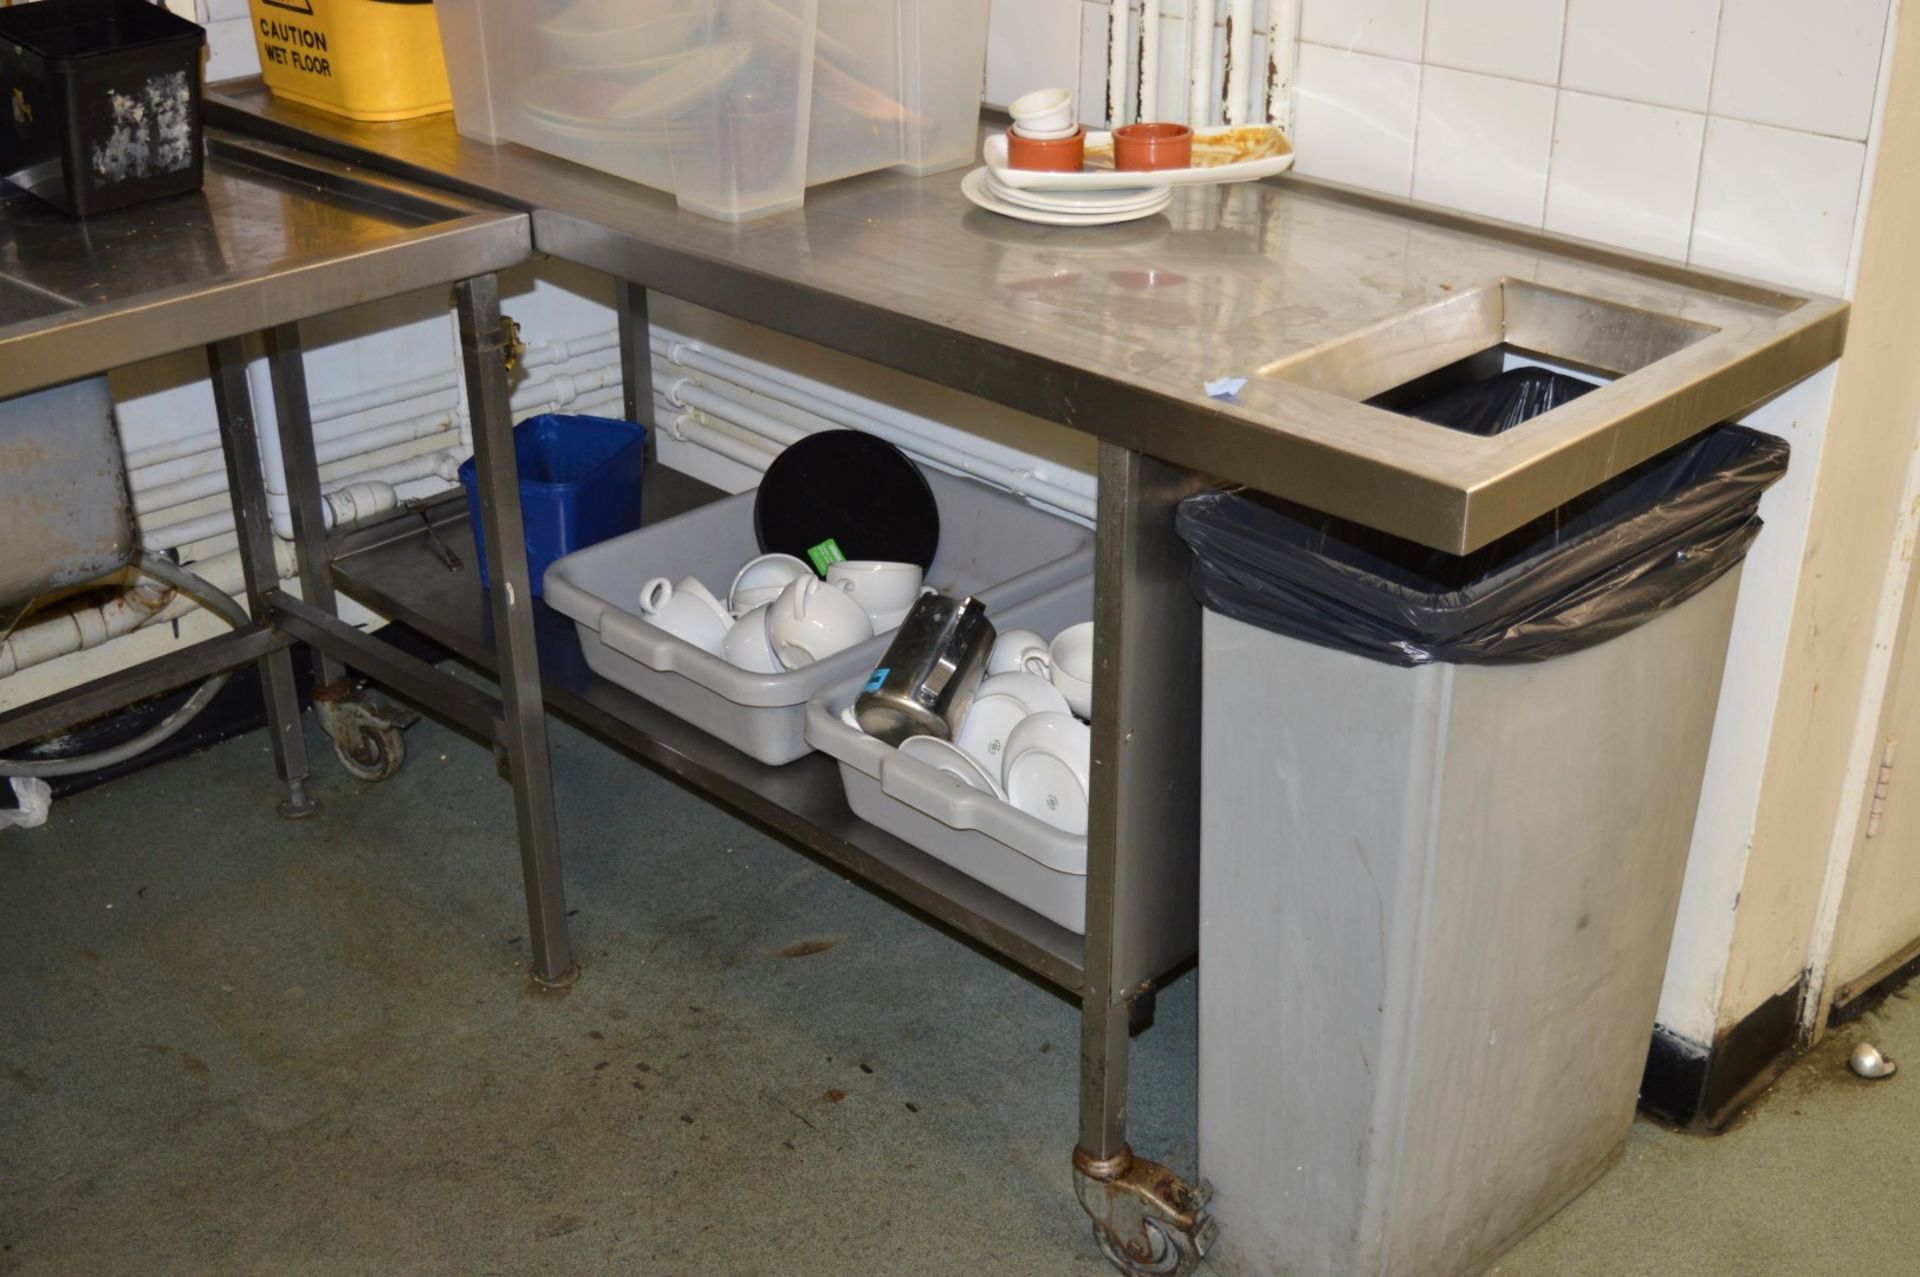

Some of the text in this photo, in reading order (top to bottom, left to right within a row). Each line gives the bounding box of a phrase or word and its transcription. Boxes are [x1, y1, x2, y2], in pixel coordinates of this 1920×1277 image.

[260, 18, 328, 52] CAUTION
[264, 42, 332, 78] WET FLOOR
